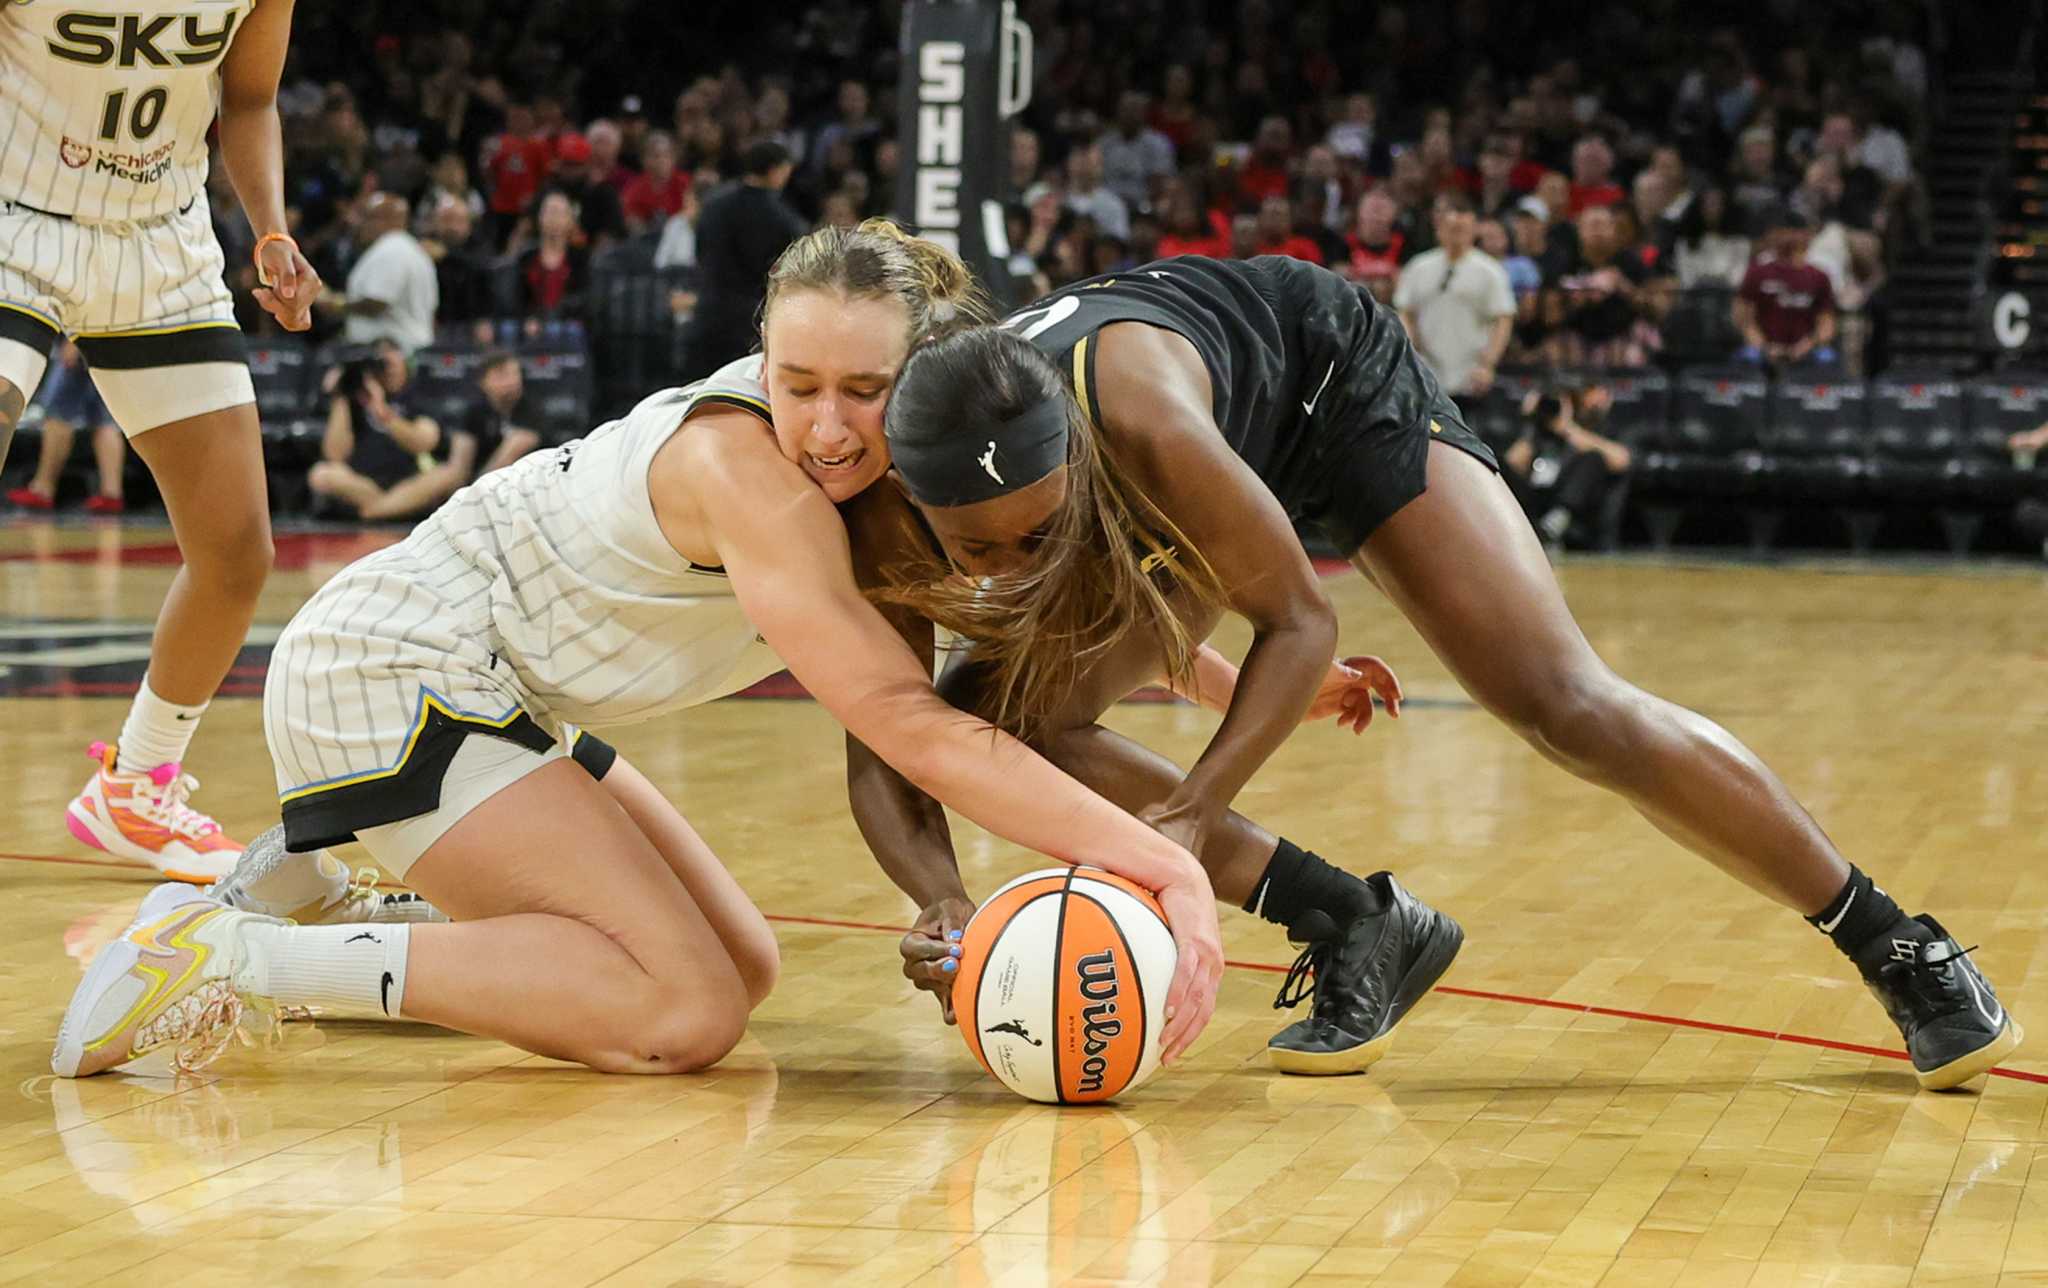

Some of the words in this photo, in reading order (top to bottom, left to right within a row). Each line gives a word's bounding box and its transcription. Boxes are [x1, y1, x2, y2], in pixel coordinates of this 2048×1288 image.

[47, 7, 240, 68] SKY
[99, 87, 169, 142] 10
[1993, 292, 2030, 348] C
[1076, 947, 1121, 1094] Wilson
